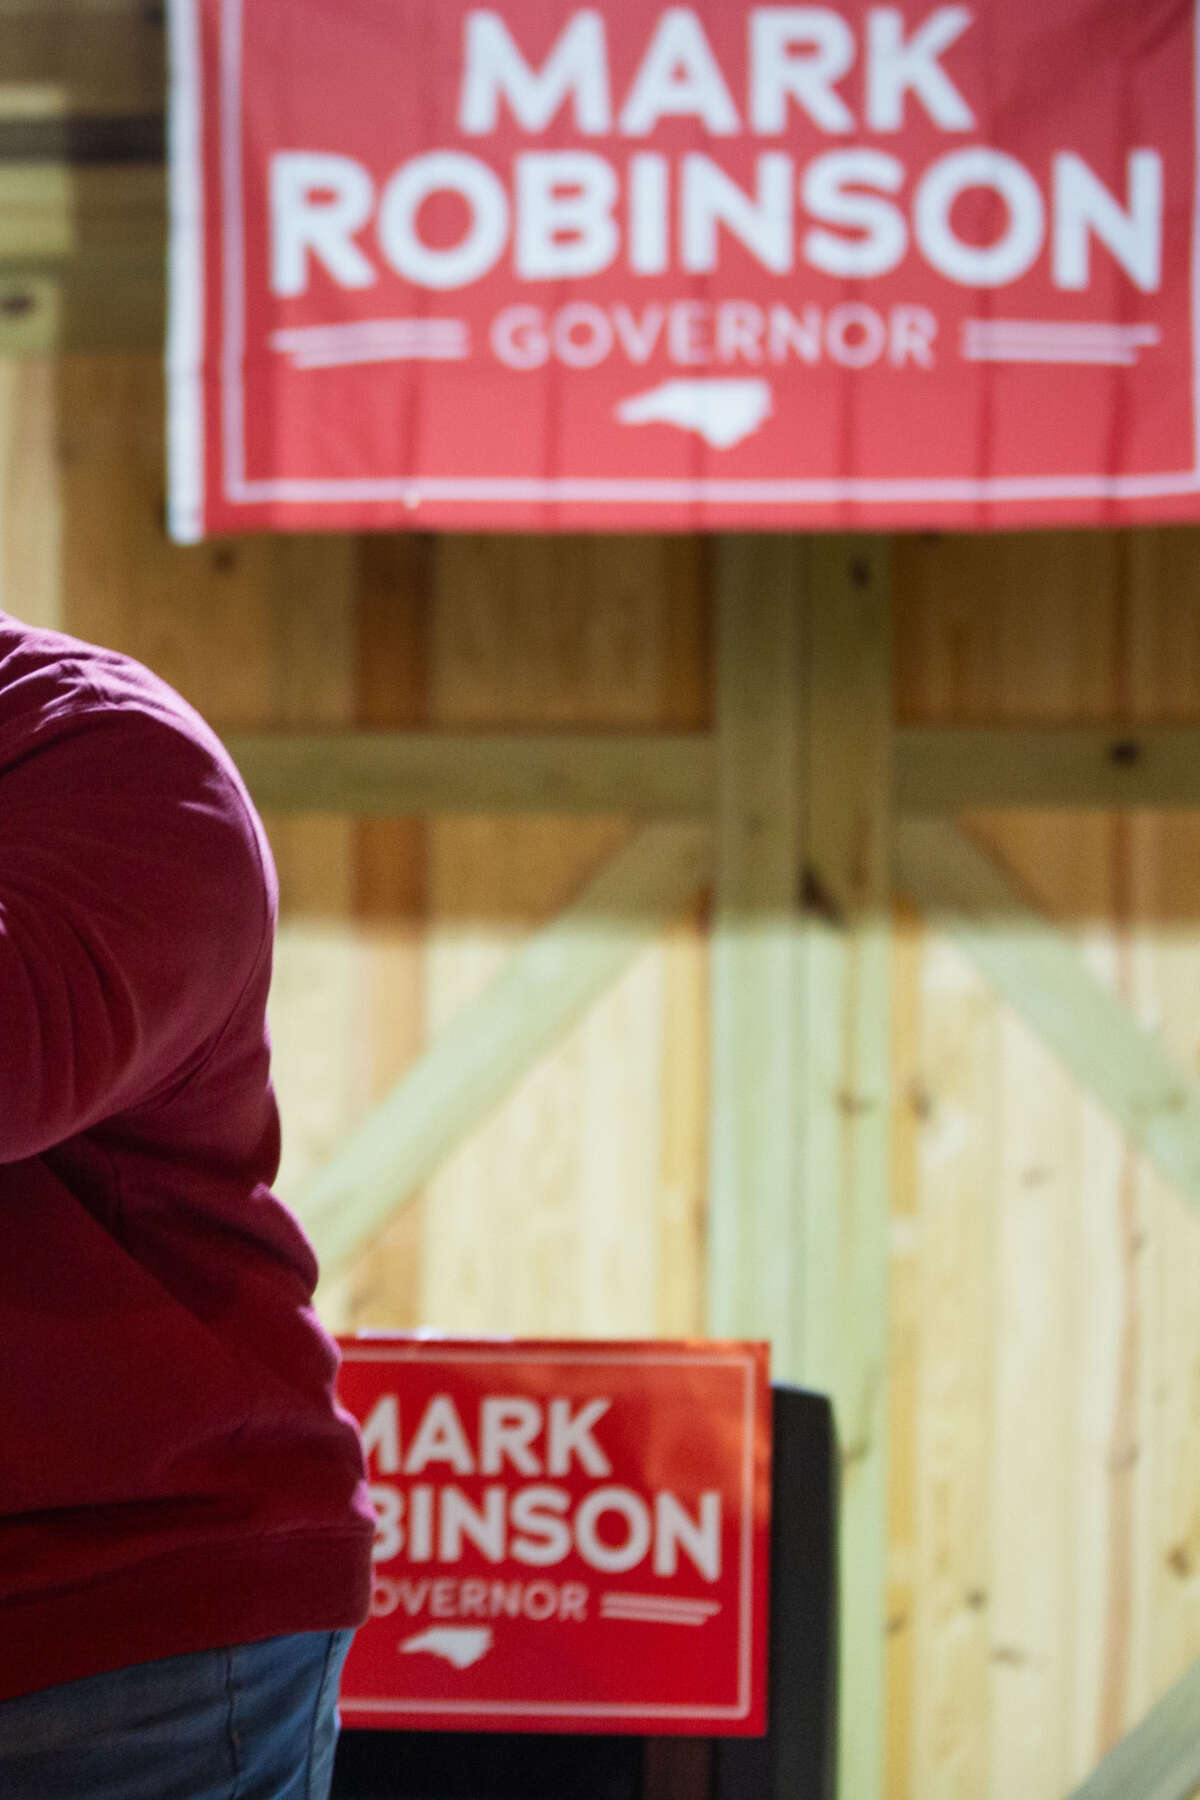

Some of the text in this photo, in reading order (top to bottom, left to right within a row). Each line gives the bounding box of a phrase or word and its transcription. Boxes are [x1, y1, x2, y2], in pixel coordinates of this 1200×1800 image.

[457, 5, 975, 137] MARK
[269, 146, 1162, 296] ROBINSON
[489, 300, 937, 370] GOVERNOR
